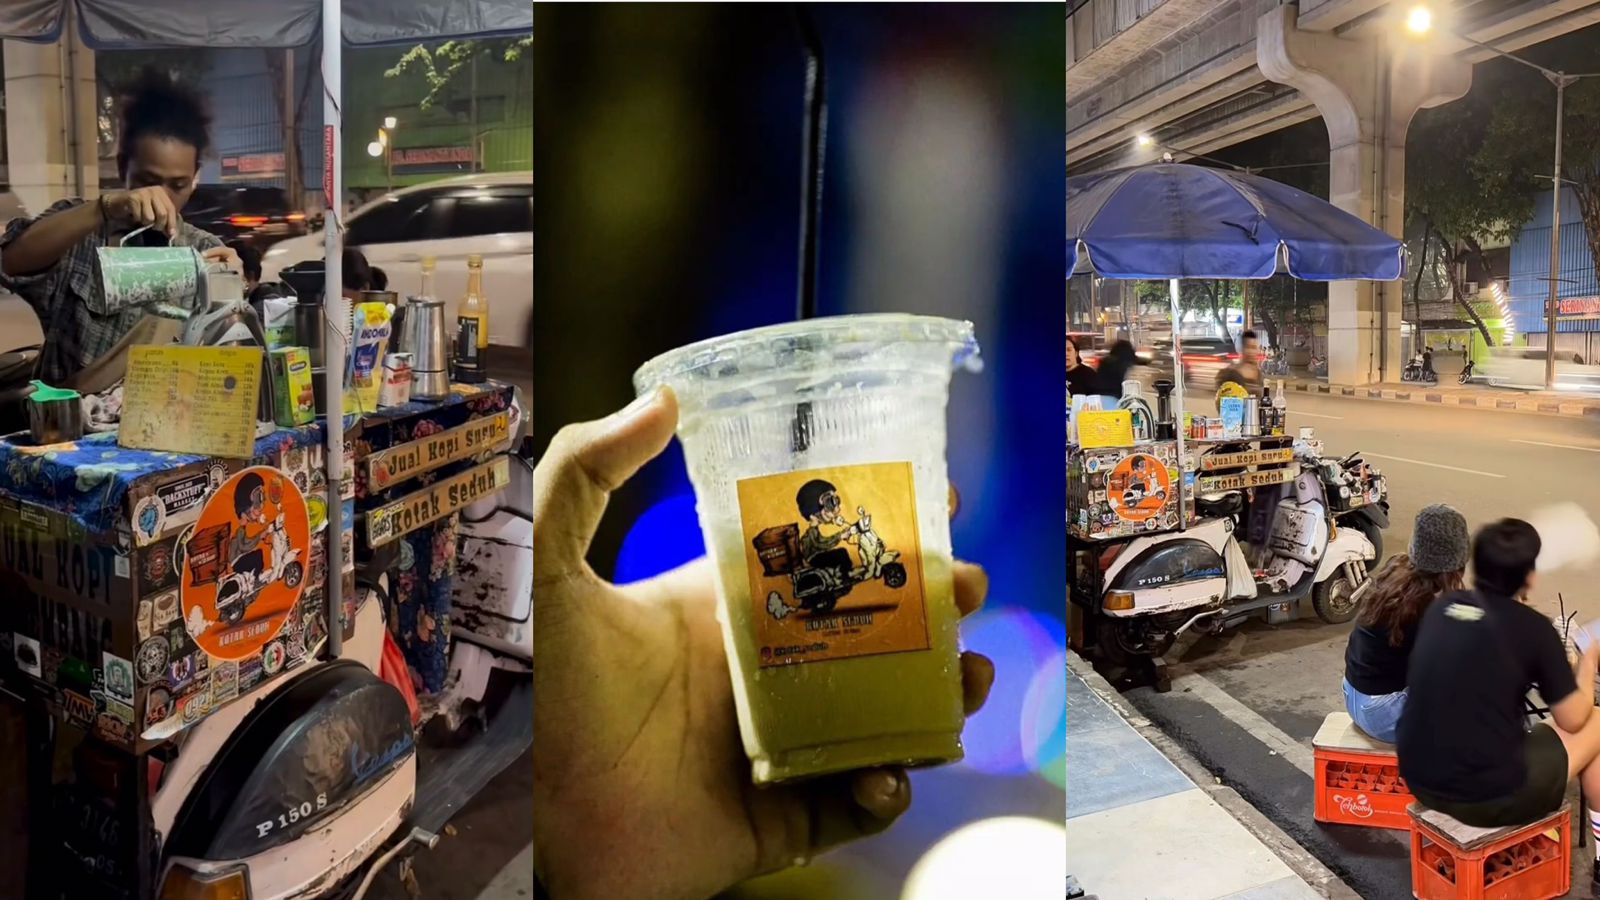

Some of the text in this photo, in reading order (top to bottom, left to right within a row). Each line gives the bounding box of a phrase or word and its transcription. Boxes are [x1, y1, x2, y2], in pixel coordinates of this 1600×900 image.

[389, 445, 420, 475] Jual
[428, 432, 459, 460] Kopi
[1211, 456, 1232, 465] Jual
[1236, 454, 1257, 465] Kopi
[1213, 476, 1245, 490] Kotak
[1251, 471, 1284, 485] Seduh
[391, 491, 440, 536] Kotak
[448, 467, 496, 506] Seduh
[1147, 576, 1163, 584] 150
[1164, 574, 1170, 582] S
[256, 791, 328, 838] P 150 S
